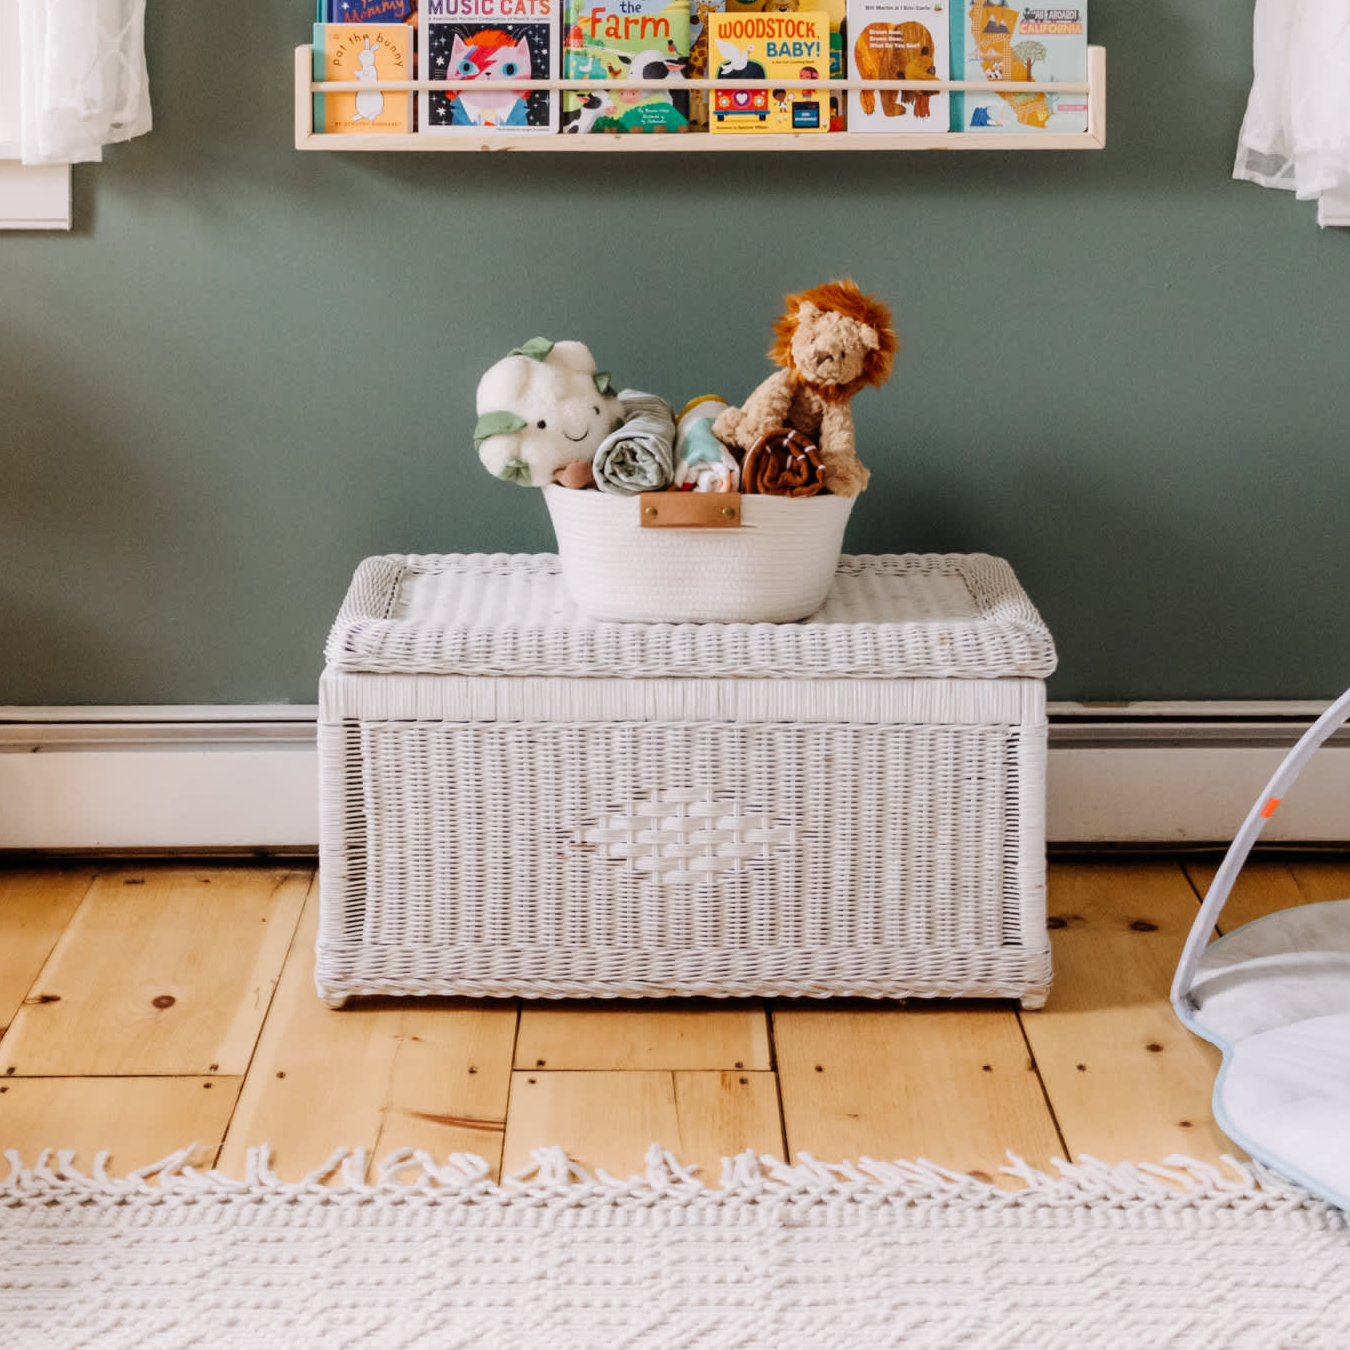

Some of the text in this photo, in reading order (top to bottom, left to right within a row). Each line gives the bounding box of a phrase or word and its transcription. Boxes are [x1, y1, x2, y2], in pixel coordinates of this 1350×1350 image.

[619, 1, 642, 13] the
[591, 7, 670, 40] Farm
[1019, 22, 1082, 34] CALIFORNIA
[333, 32, 404, 67] pat the bunny
[766, 42, 821, 58] BABY!
